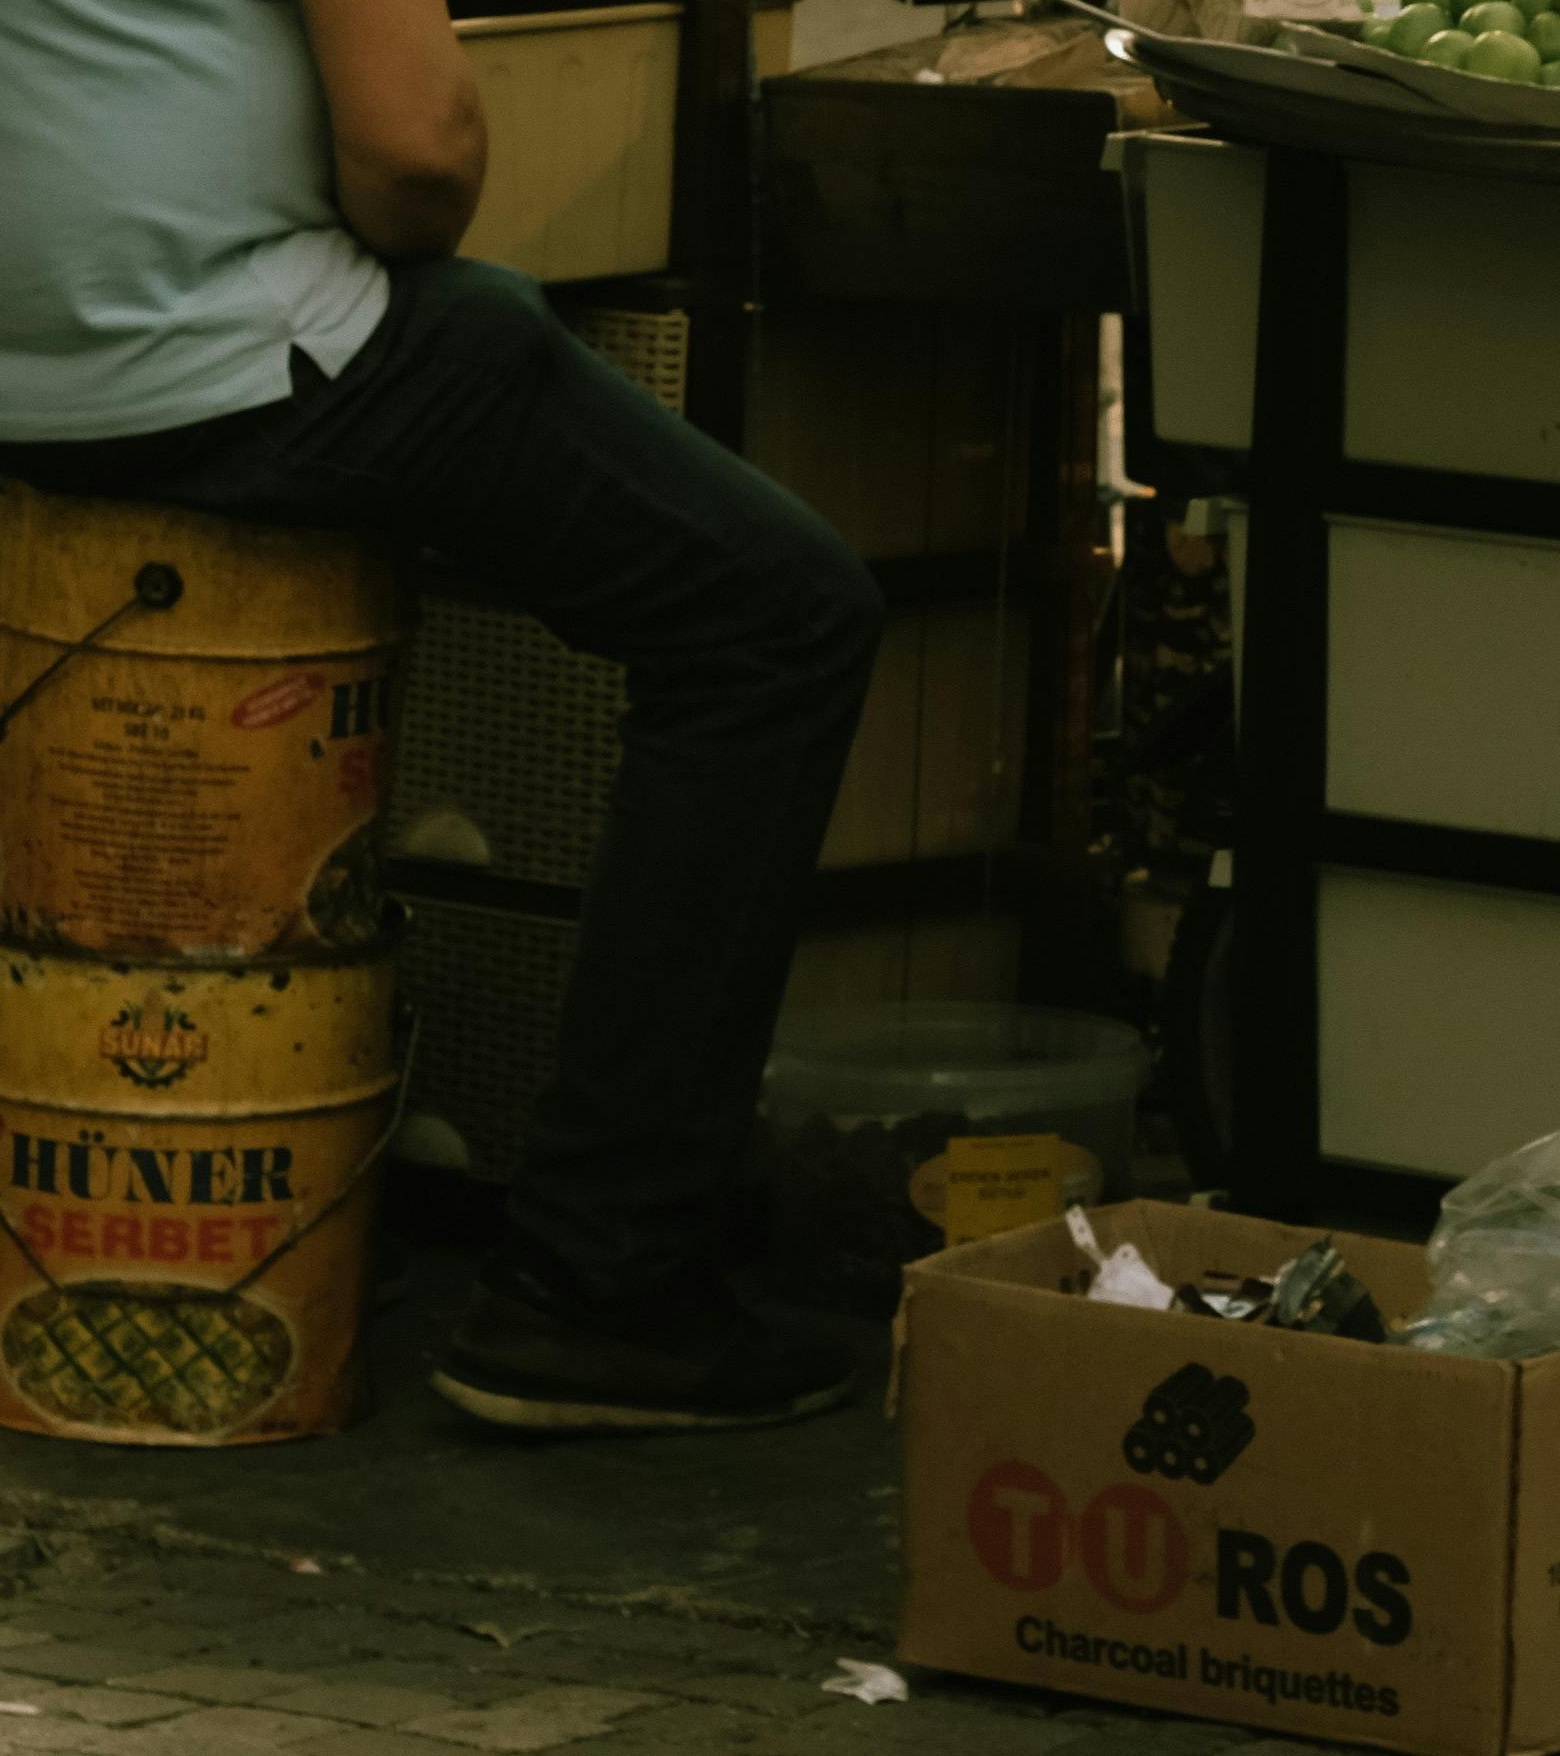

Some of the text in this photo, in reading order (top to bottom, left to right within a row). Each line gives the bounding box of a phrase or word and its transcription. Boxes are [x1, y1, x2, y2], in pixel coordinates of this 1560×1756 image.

[11, 1130, 296, 1206] HÜNER
[23, 1203, 280, 1263] SERBET
[1015, 1615, 1401, 1718] Charcoal briquettes
